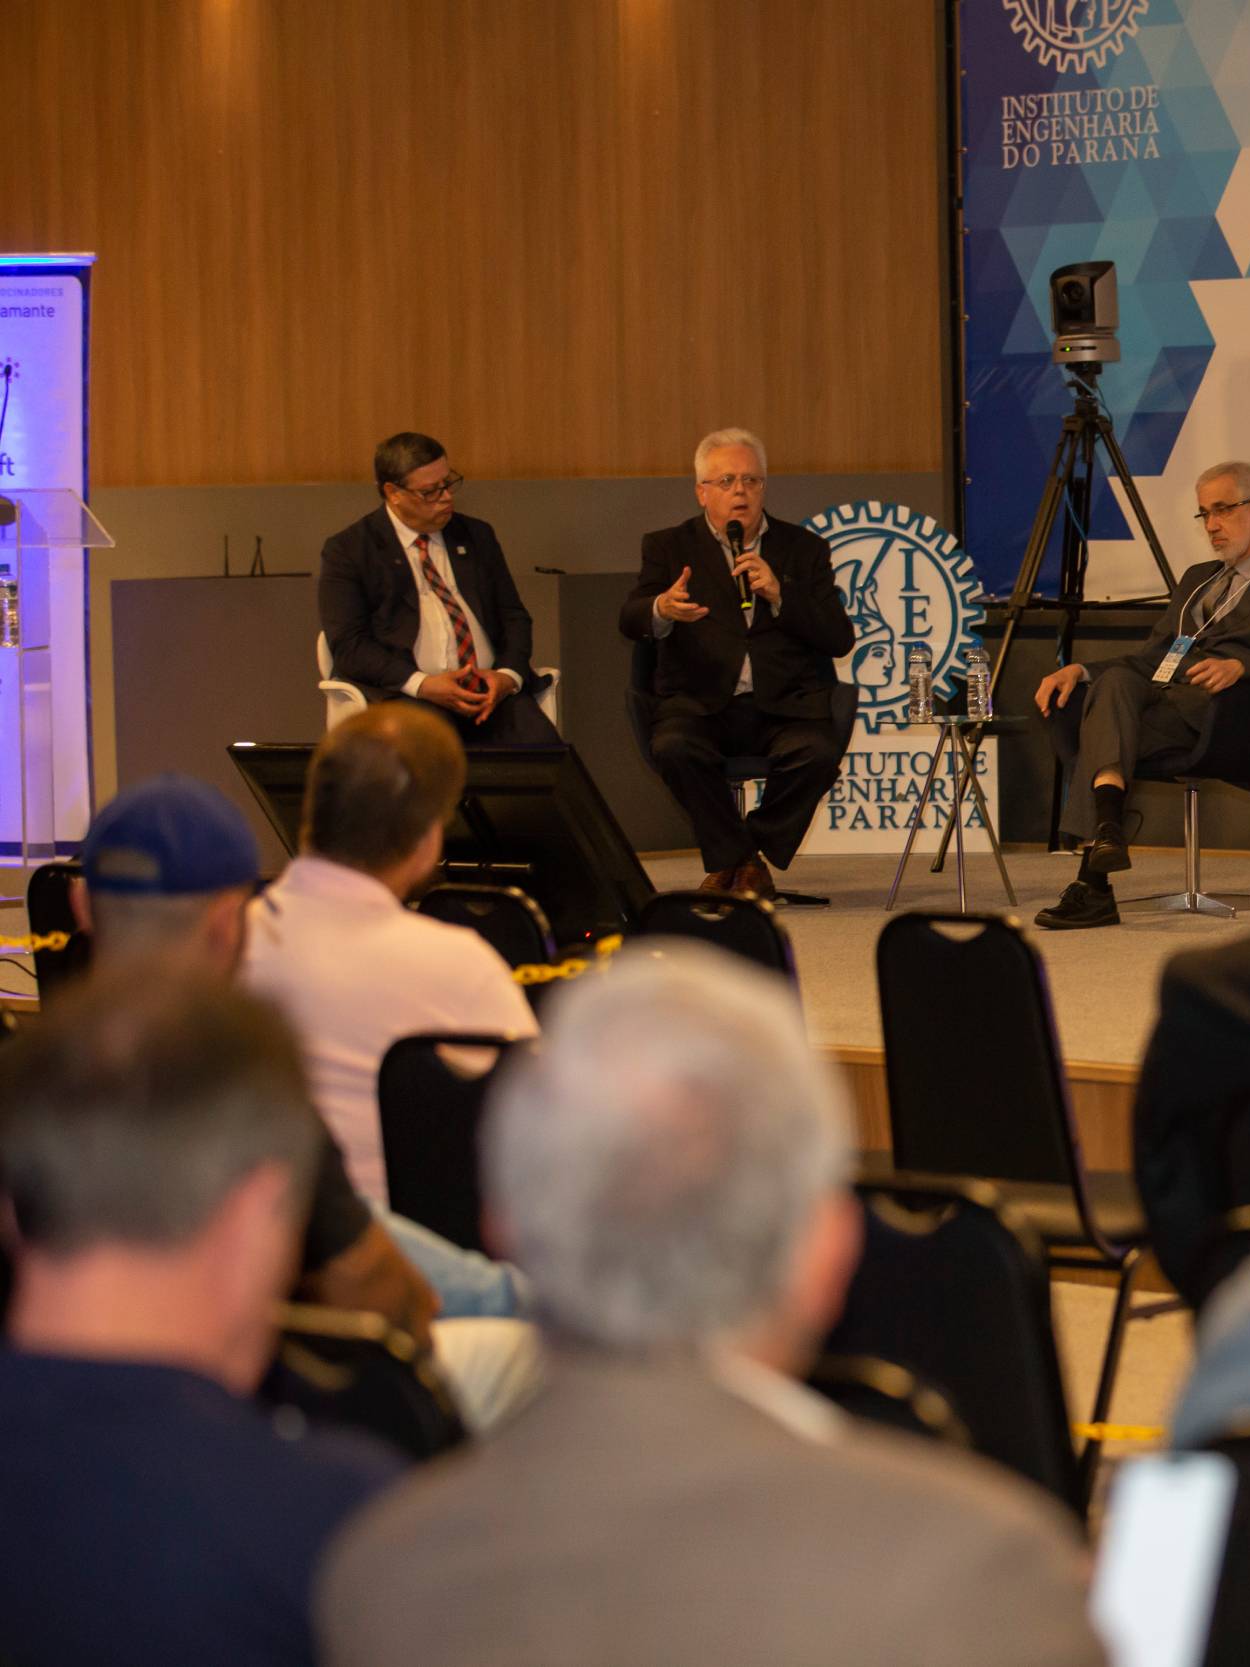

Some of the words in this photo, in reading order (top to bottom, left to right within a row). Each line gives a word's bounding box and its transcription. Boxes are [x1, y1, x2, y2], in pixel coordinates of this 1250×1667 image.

[1001, 88, 1125, 119] INSTITUTO
[1130, 84, 1160, 109] DE
[1002, 110, 1160, 145] ENGENHARIA
[1003, 144, 1040, 169] DO
